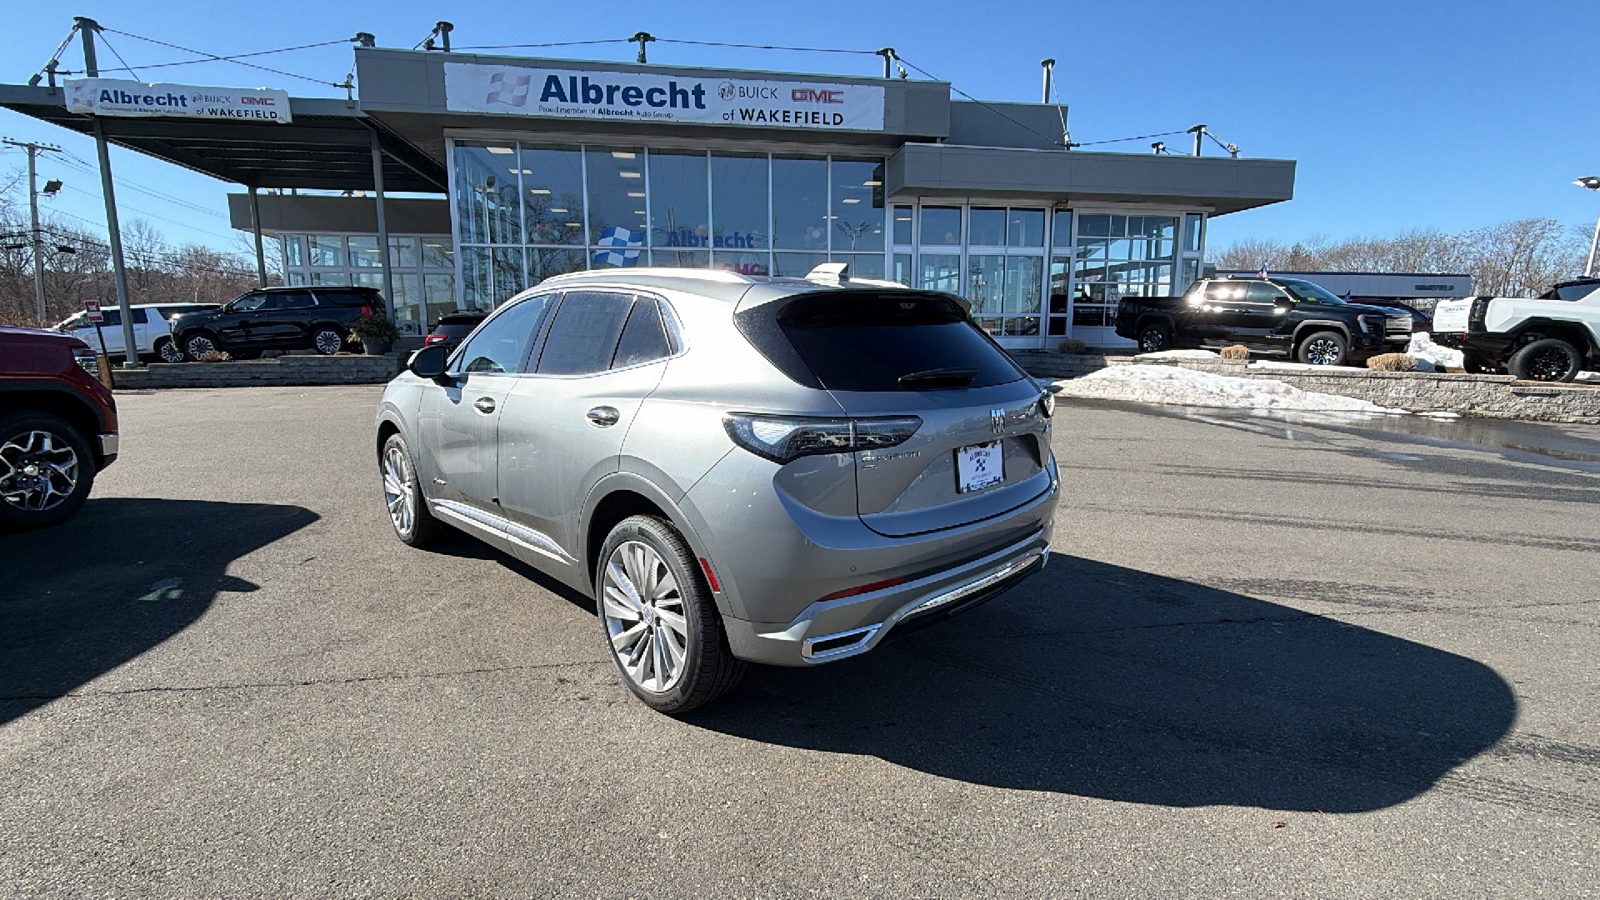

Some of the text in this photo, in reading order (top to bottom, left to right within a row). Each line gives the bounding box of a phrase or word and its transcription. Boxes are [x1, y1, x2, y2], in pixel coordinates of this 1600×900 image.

[99, 89, 188, 107] Albrecht
[204, 95, 276, 106] BUICK GMC
[539, 74, 707, 110] Albrecht
[738, 86, 844, 104] BUICK GMC
[196, 108, 278, 119] of WAKEFIELD
[538, 105, 674, 119] Proud member of Albrecht Auto Group
[722, 108, 844, 126] of WAKEFIELD
[666, 231, 754, 248] Albrecht
